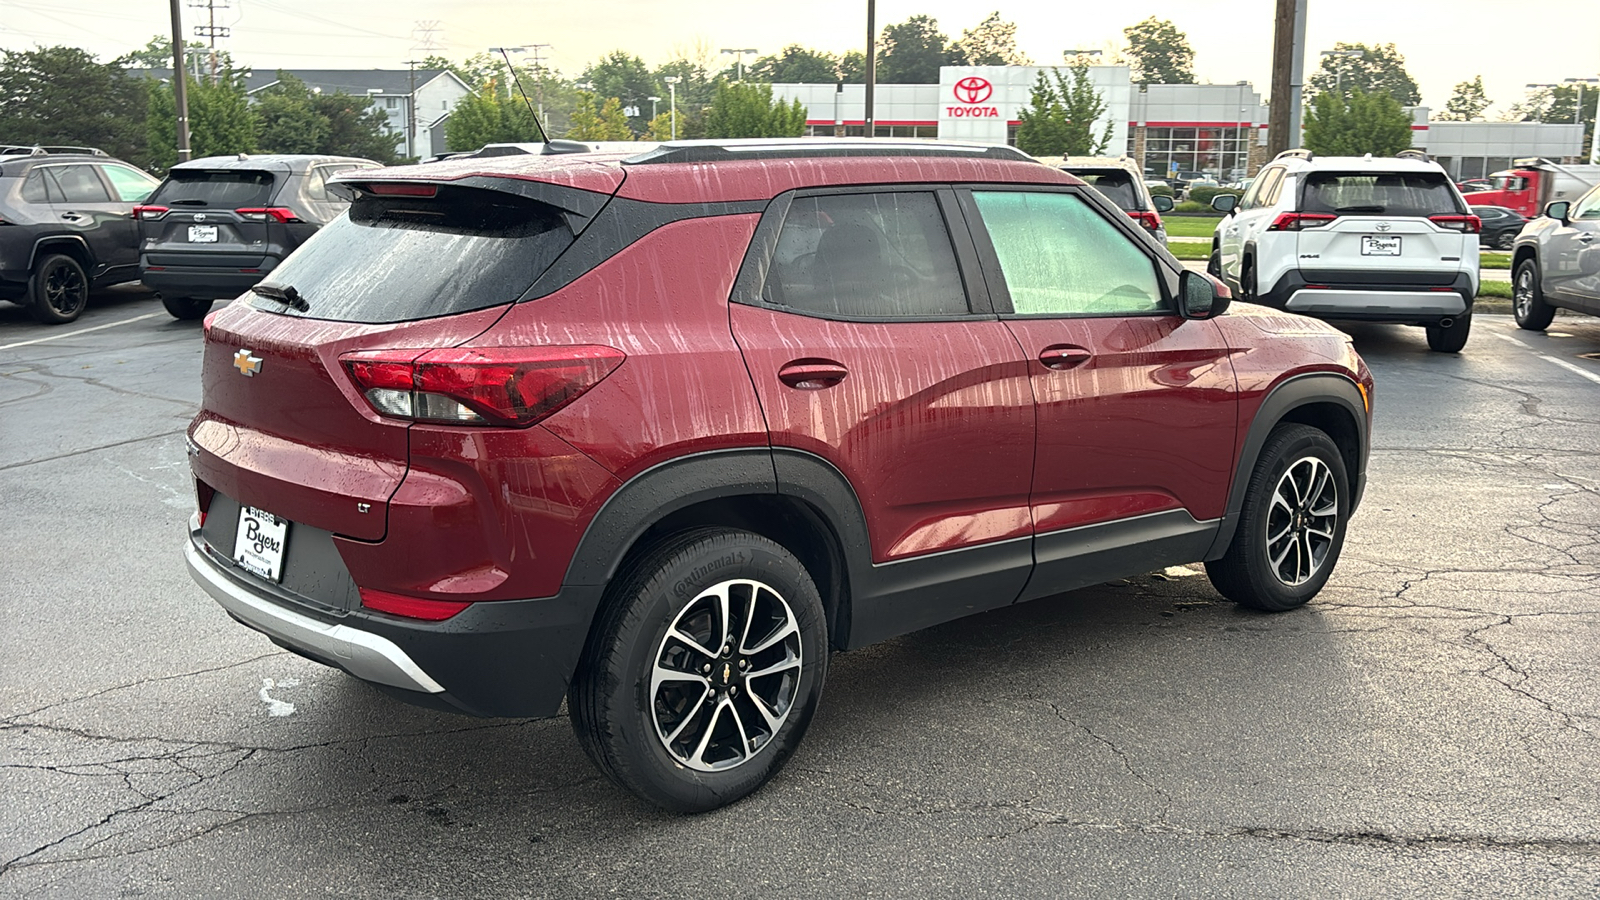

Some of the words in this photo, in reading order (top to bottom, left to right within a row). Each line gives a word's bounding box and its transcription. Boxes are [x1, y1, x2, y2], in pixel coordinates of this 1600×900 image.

[946, 107, 999, 117] TOYOTA
[358, 502, 371, 514] LT
[244, 517, 281, 554] Byers
[673, 551, 737, 598] Continental
